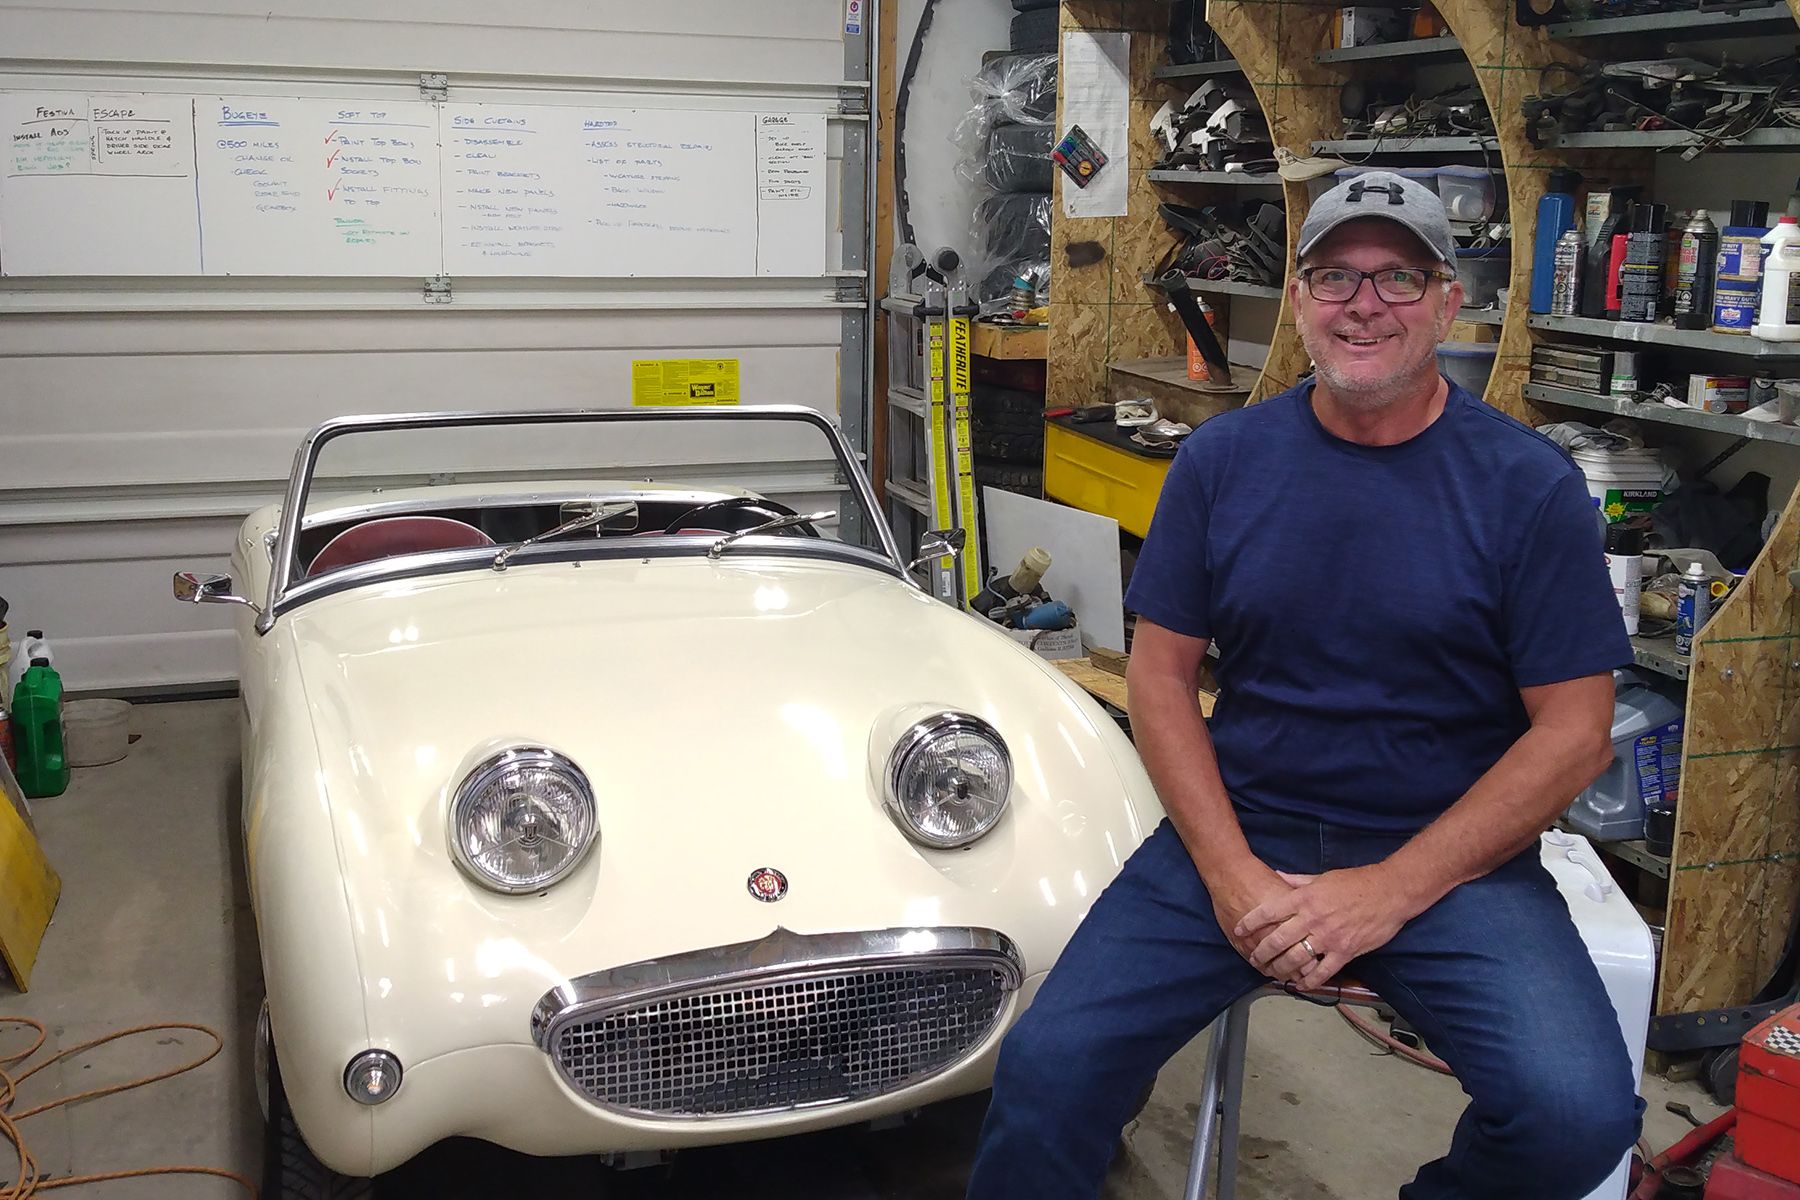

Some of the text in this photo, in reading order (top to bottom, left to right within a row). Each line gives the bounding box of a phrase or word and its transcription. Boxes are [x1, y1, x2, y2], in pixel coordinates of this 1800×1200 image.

[36, 107, 74, 118] FESTIVA
[93, 109, 135, 119] ESCAPE
[222, 106, 267, 120] BUGEYE
[338, 111, 360, 119] SOFT
[371, 137, 387, 147] TOP
[955, 320, 967, 390] FEATHERLITE
[1623, 490, 1658, 498] KIRKLAND
